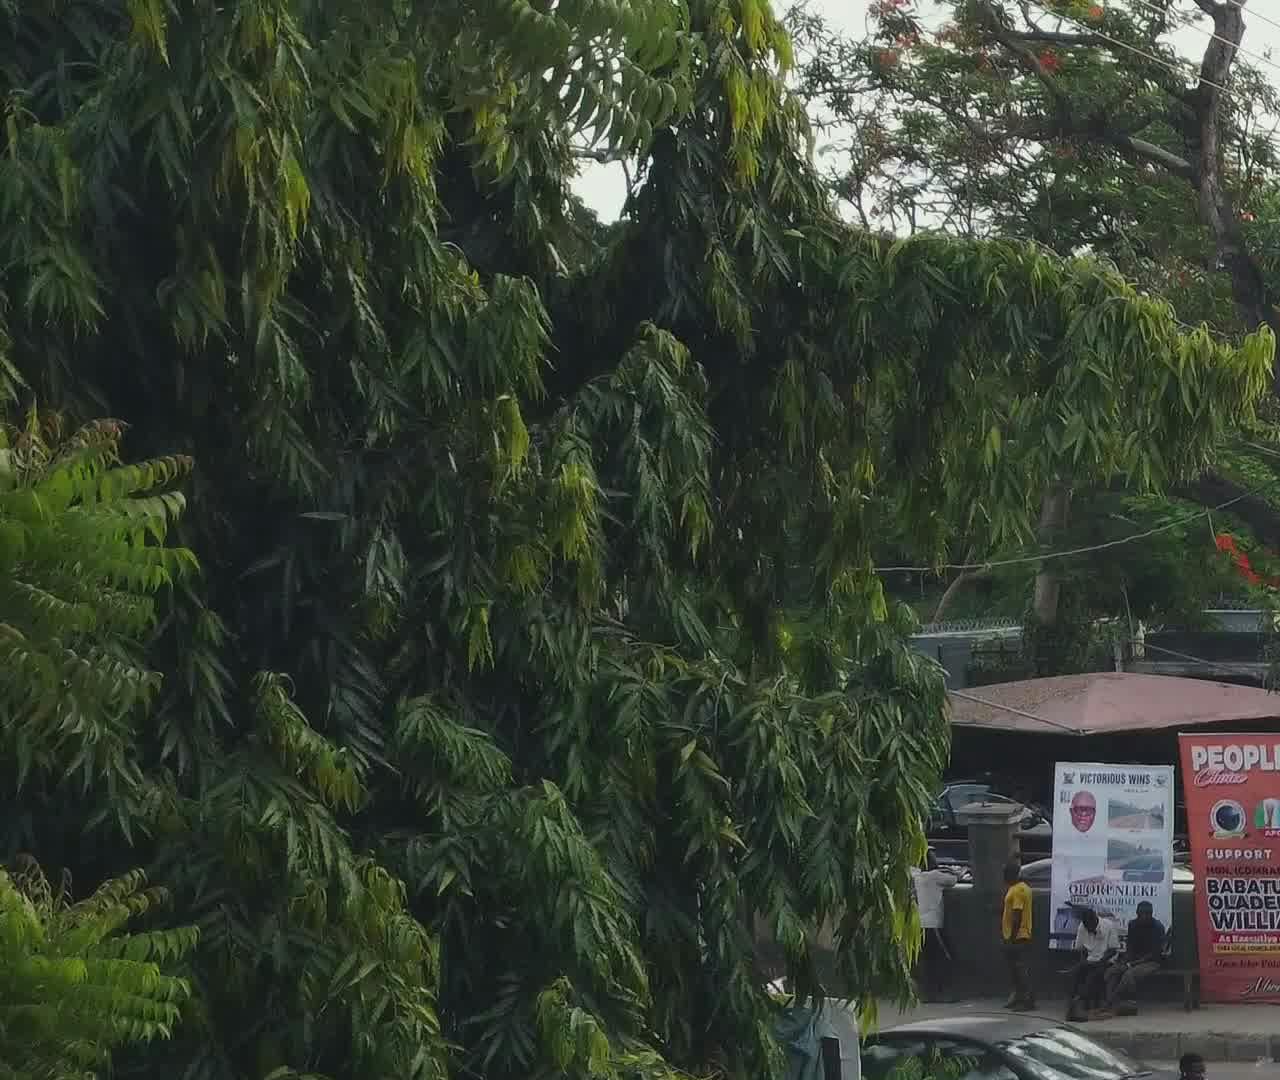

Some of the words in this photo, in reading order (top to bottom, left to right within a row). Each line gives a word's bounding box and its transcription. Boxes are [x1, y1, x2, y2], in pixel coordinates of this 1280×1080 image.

[1080, 773, 1127, 785] VICTORIOUS
[1128, 774, 1152, 786] WINS
[1206, 849, 1272, 860] SUPPORT
